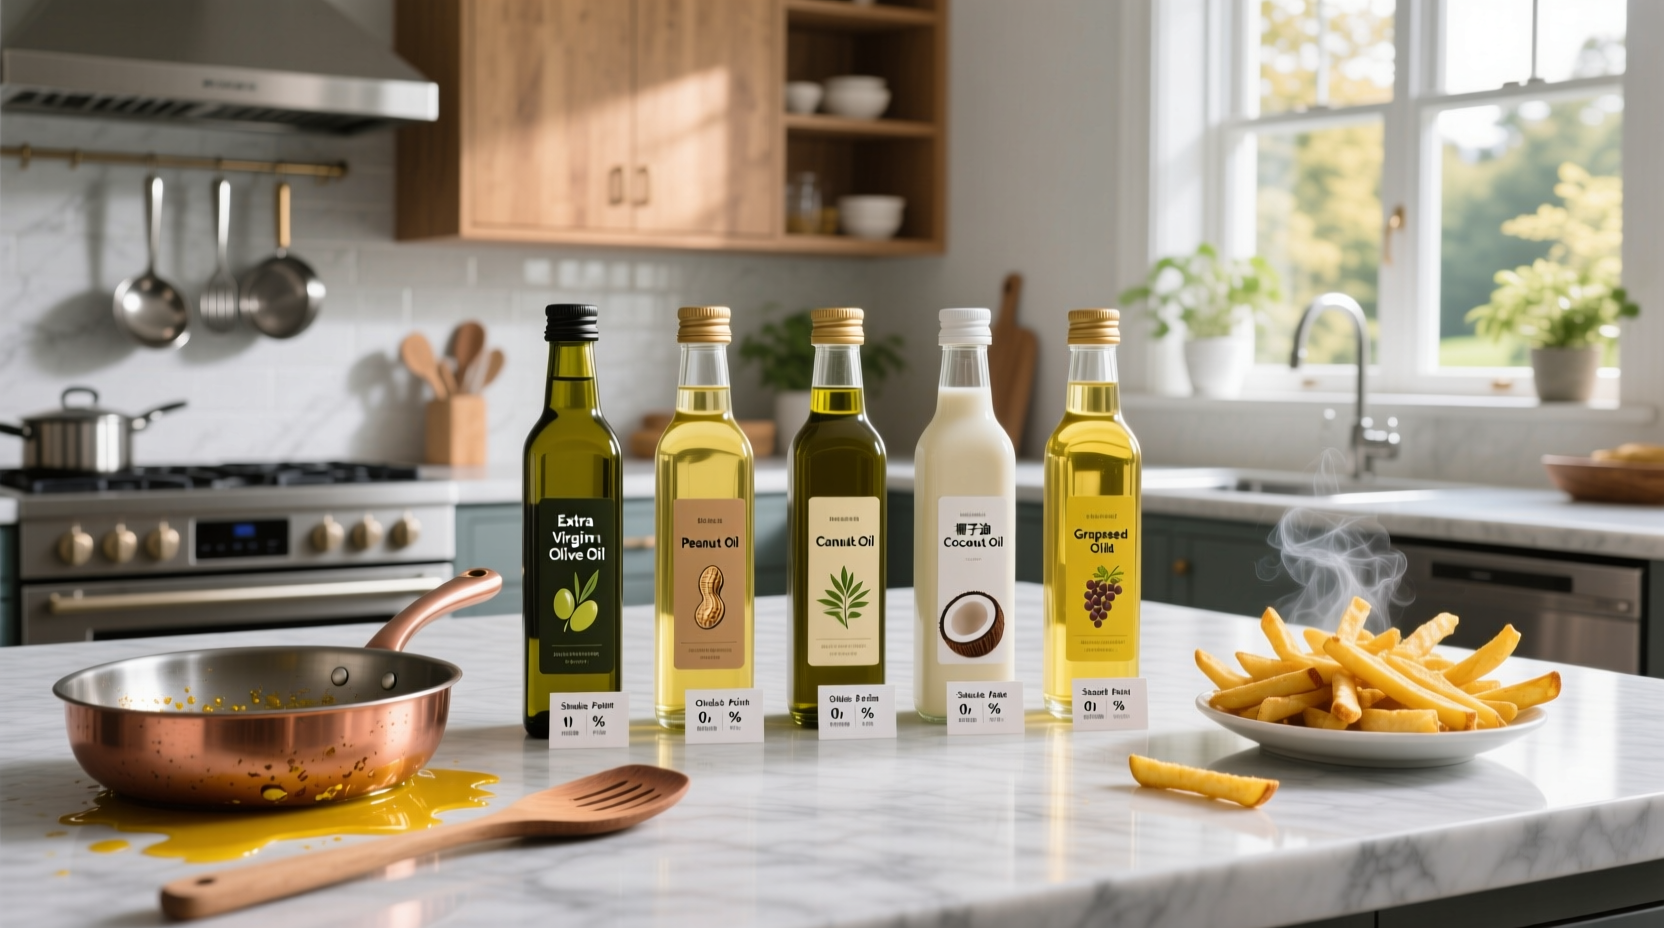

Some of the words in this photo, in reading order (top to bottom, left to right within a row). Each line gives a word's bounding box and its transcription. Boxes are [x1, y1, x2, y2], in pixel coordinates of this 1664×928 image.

[558, 514, 594, 527] Extra
[681, 537, 722, 548] Peanut
[724, 536, 739, 548] Oil
[858, 535, 875, 547] Oil
[988, 536, 1004, 547] Oil
[549, 547, 584, 561] Olive
[586, 547, 606, 561] Oil
[728, 711, 742, 723] %
[860, 706, 875, 720] %
[592, 715, 606, 728] %
